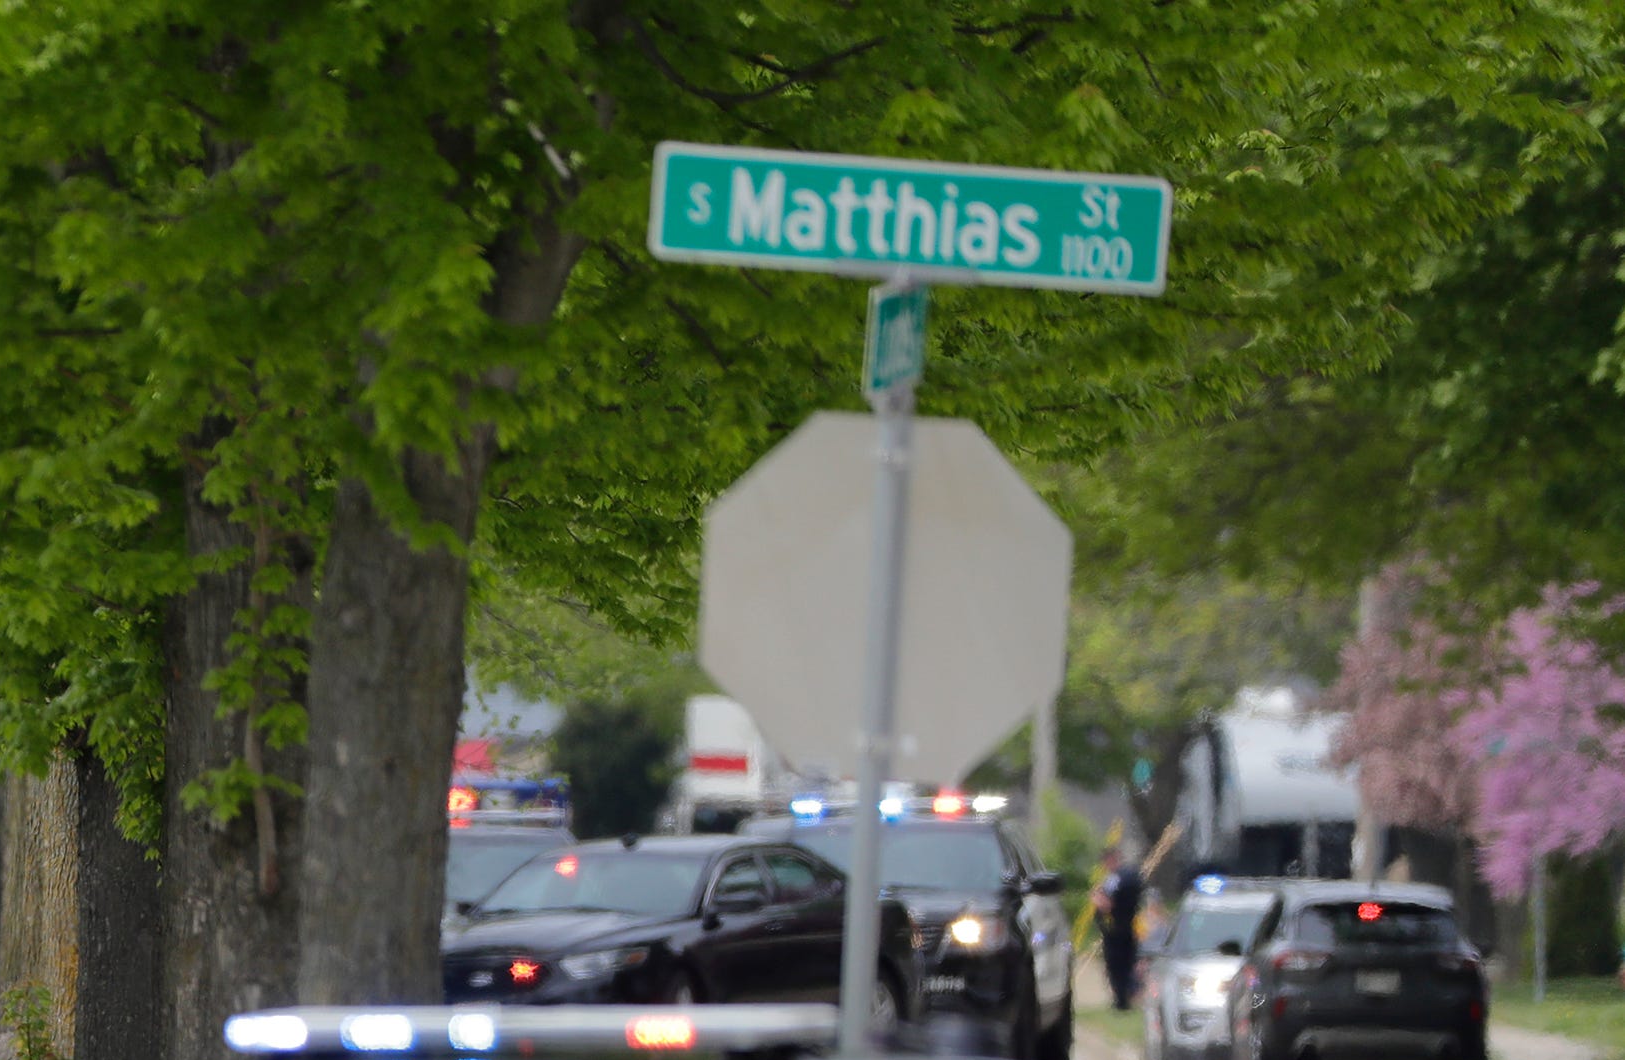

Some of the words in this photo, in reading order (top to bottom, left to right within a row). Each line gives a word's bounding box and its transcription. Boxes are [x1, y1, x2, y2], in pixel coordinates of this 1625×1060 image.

[687, 181, 713, 225] S
[727, 166, 1042, 268] Matthias
[1079, 184, 1122, 231] St
[1059, 234, 1135, 281] 1100
